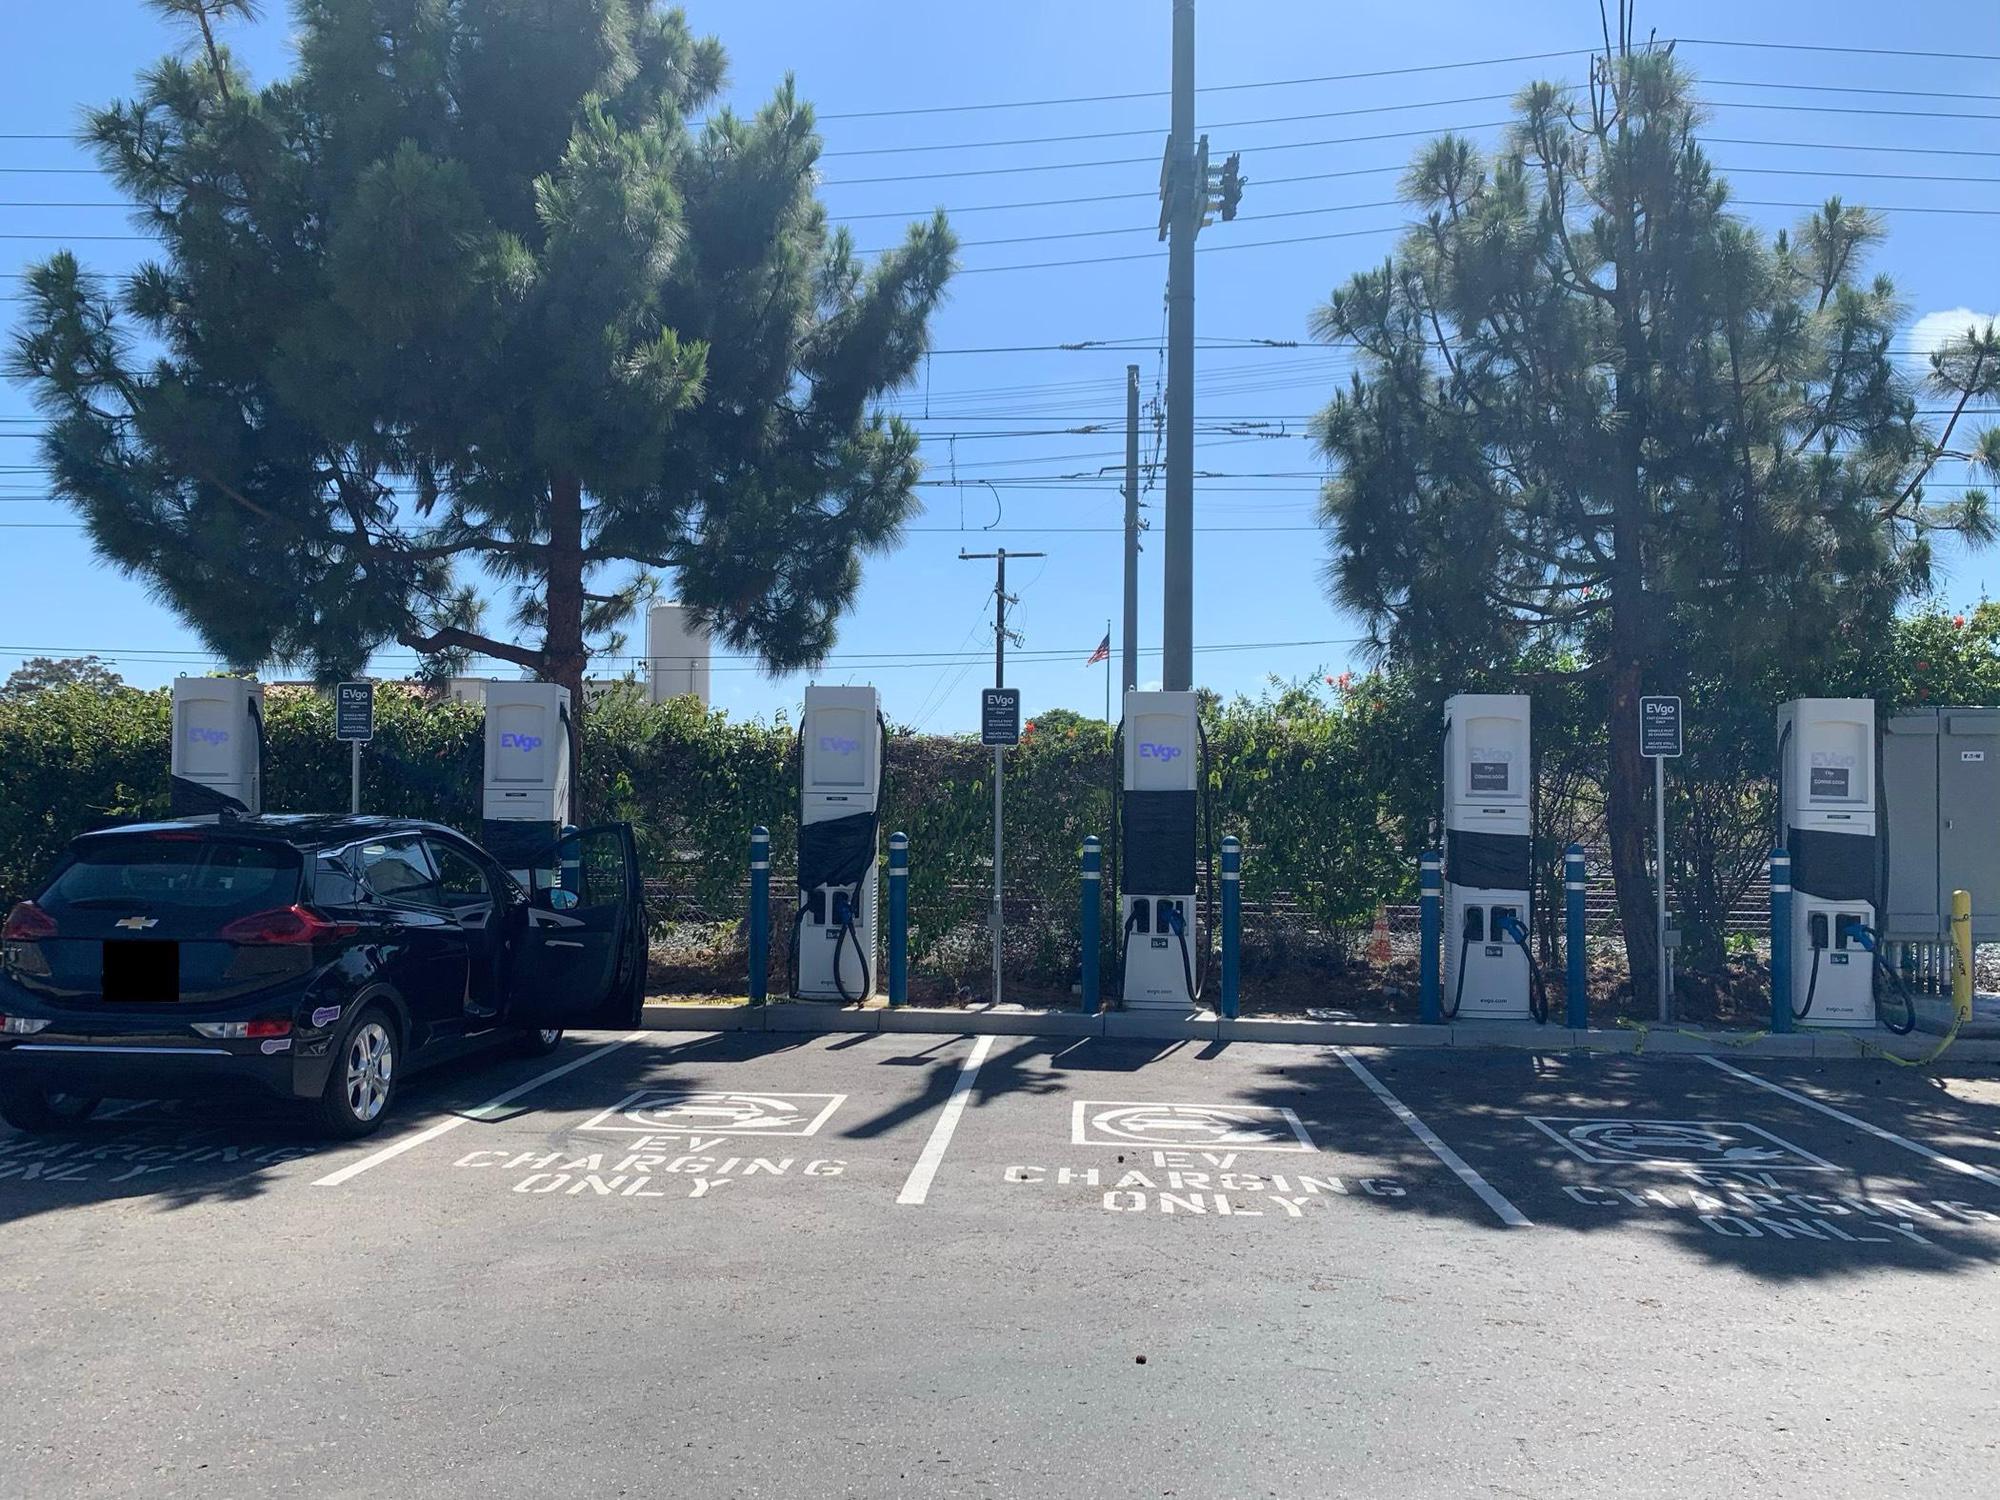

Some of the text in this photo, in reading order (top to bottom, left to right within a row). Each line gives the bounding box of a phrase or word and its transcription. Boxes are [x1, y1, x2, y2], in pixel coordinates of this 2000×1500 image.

[342, 689, 368, 701] EVgo
[987, 695, 1014, 707] EVgo
[1646, 703, 1675, 716] EVgo
[188, 727, 229, 746] EVgo
[501, 733, 542, 752] EVgo
[820, 736, 859, 756] EVgo
[1138, 743, 1181, 762] EVgo
[627, 1135, 728, 1152] EV
[452, 1150, 848, 1177] CHARGING
[1152, 1150, 1238, 1169] EV
[512, 1173, 732, 1198] ONLY
[1003, 1165, 1406, 1196] CHARGING
[1680, 1168, 1783, 1190] EV
[1103, 1190, 1310, 1217] ONLY
[1561, 1185, 2000, 1222] CHARGING
[1697, 1214, 1934, 1245] ONLY
